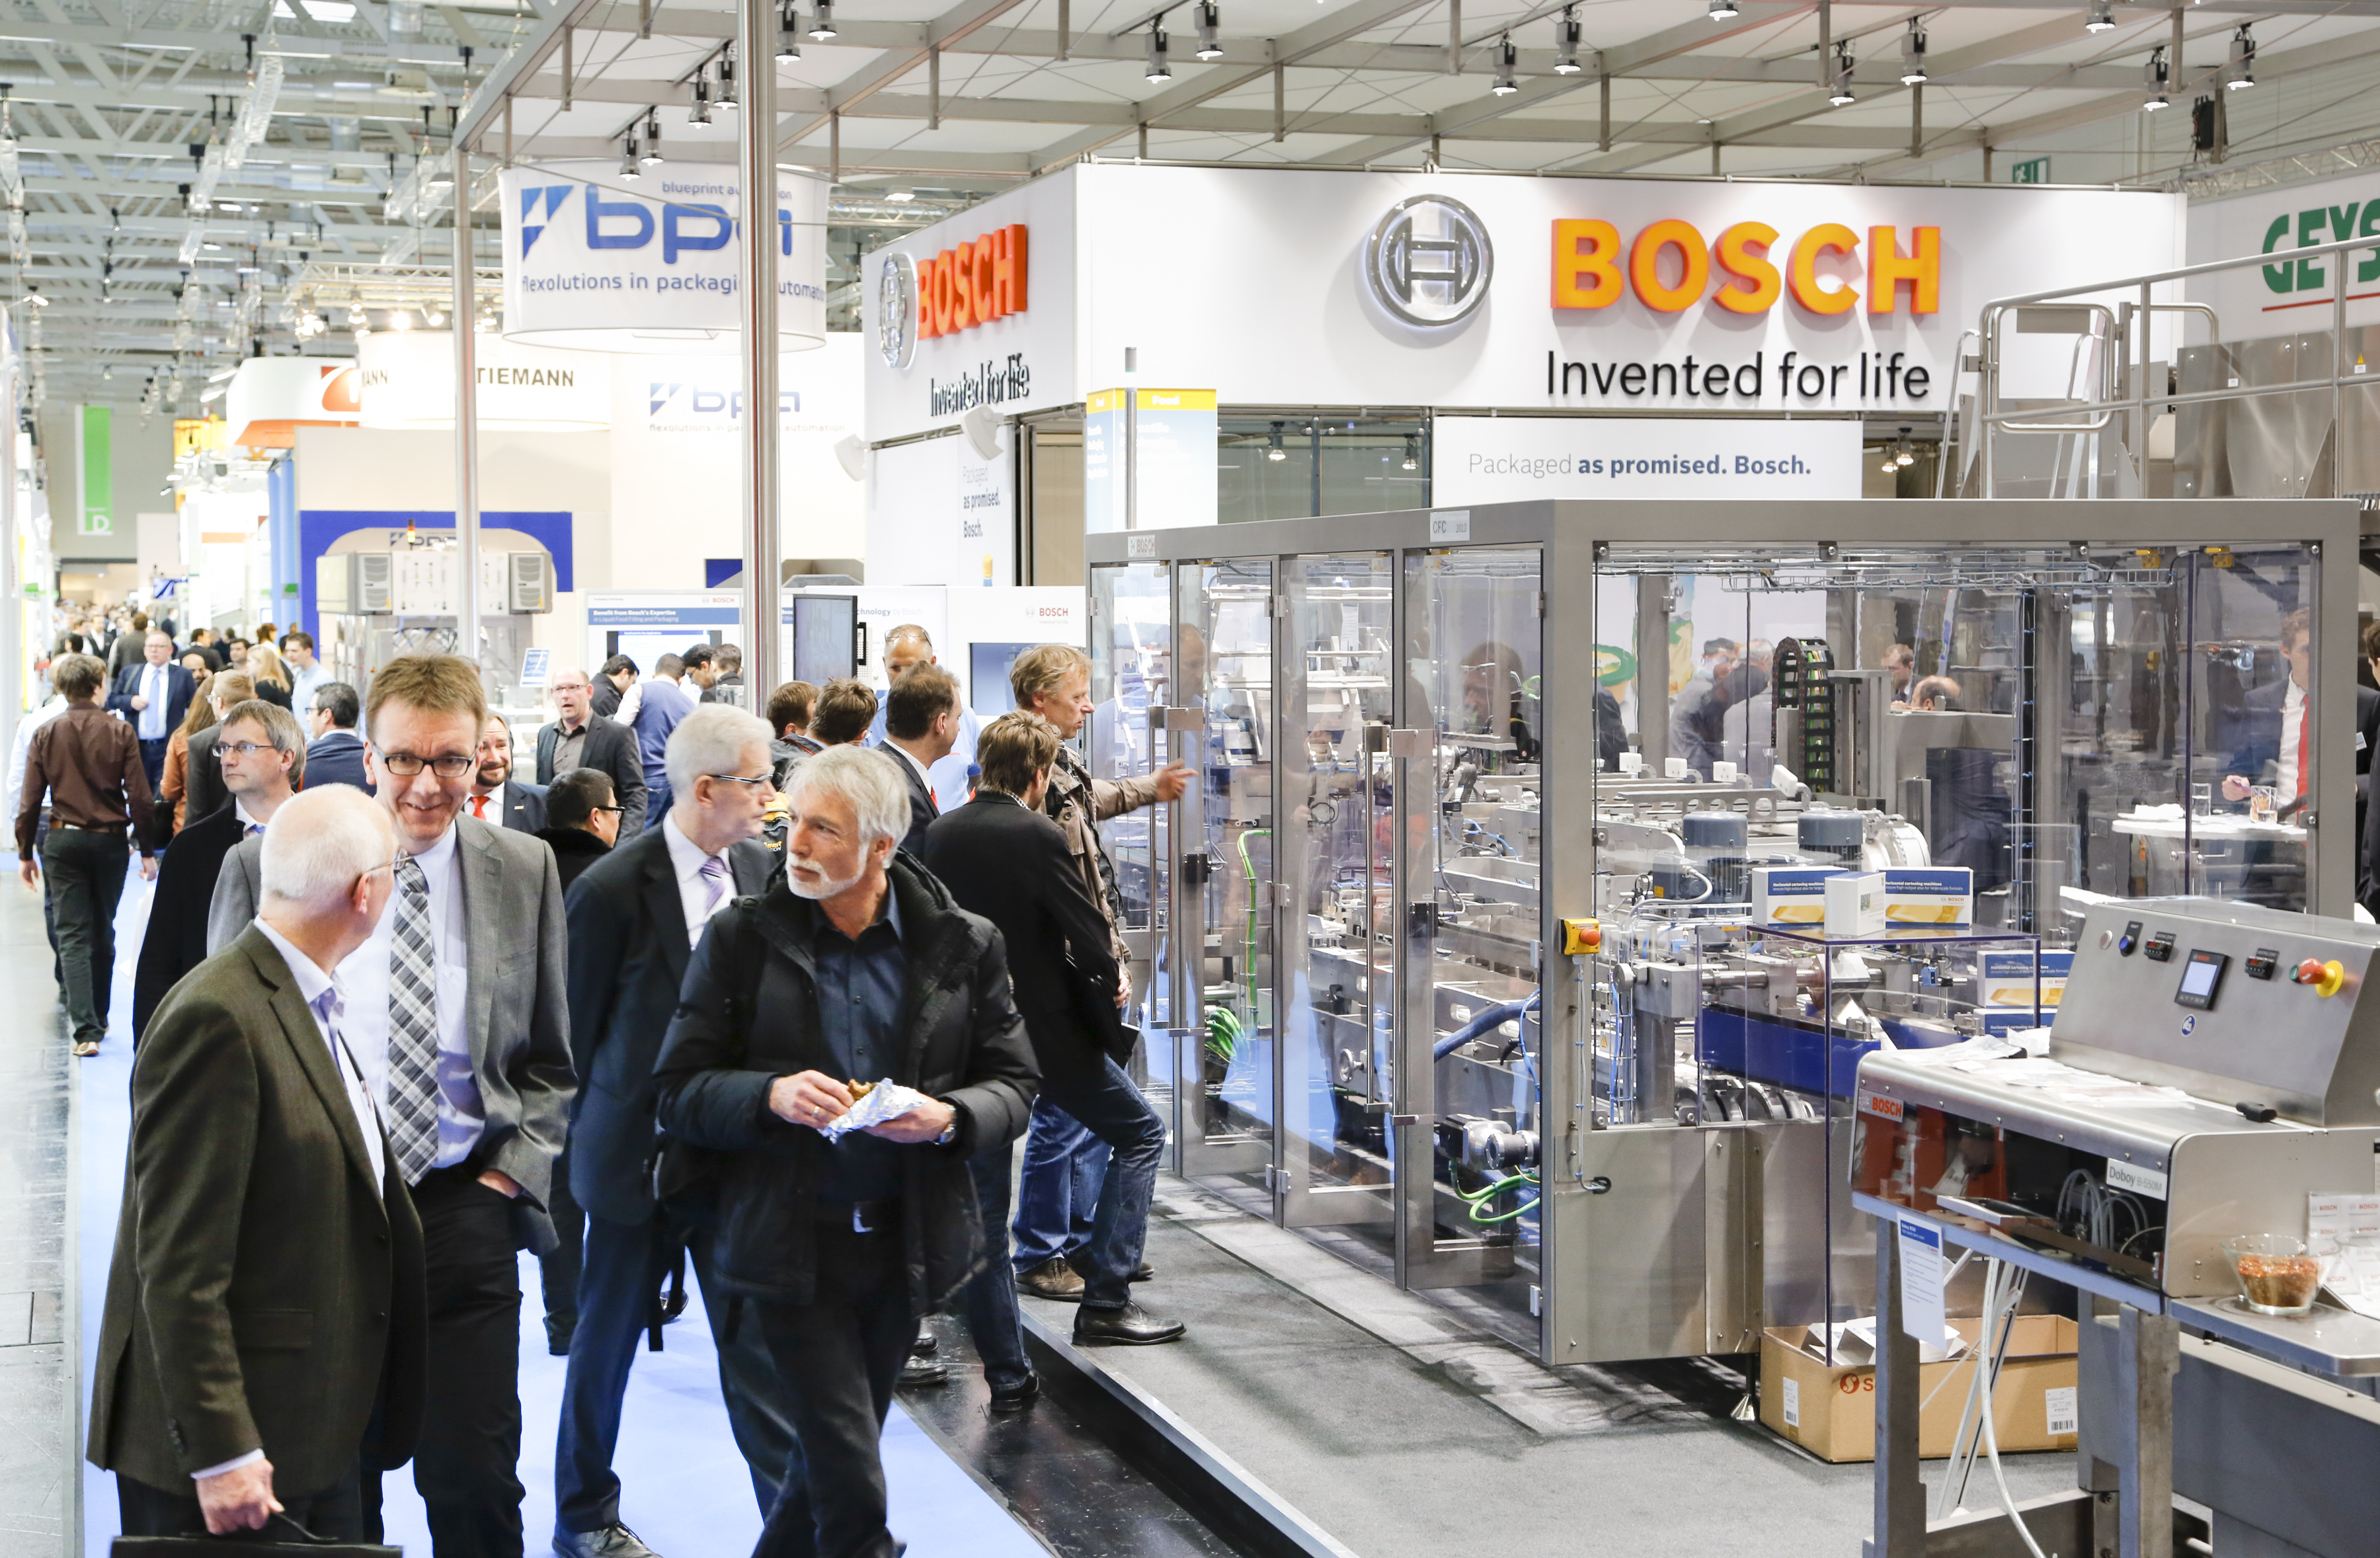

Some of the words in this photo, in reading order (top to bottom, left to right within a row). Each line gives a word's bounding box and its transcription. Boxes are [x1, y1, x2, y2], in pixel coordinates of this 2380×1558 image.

[662, 181, 724, 195] blueprint
[1550, 218, 1940, 315] BOSCH
[522, 272, 622, 293] flexolutions
[630, 272, 649, 290] in
[657, 273, 740, 294] packagi
[917, 223, 1027, 341] BOSCH
[931, 362, 983, 417] Invented
[986, 360, 1006, 405] for
[1008, 352, 1029, 401] life
[1548, 350, 1763, 397] Invented
[1778, 351, 1848, 399] for
[1860, 351, 1930, 399] life
[1152, 395, 1179, 405] Food
[1469, 453, 1571, 479] Packaged
[1578, 458, 1604, 475] as
[1610, 454, 1727, 479] promised.
[1735, 454, 1811, 475] Bosch.
[964, 495, 970, 509] as
[971, 487, 1000, 512] promised.
[93, 515, 110, 532] D
[964, 518, 983, 538] Bosch.
[1433, 520, 1447, 534] CFC
[1137, 538, 1156, 553] BOSCH
[902, 607, 923, 616] Bosch
[1039, 607, 1068, 616] BOSCH
[1872, 1096, 1902, 1118] BOSCH
[2110, 1166, 2135, 1187] Doboy
[2137, 1176, 2162, 1192] B-550M
